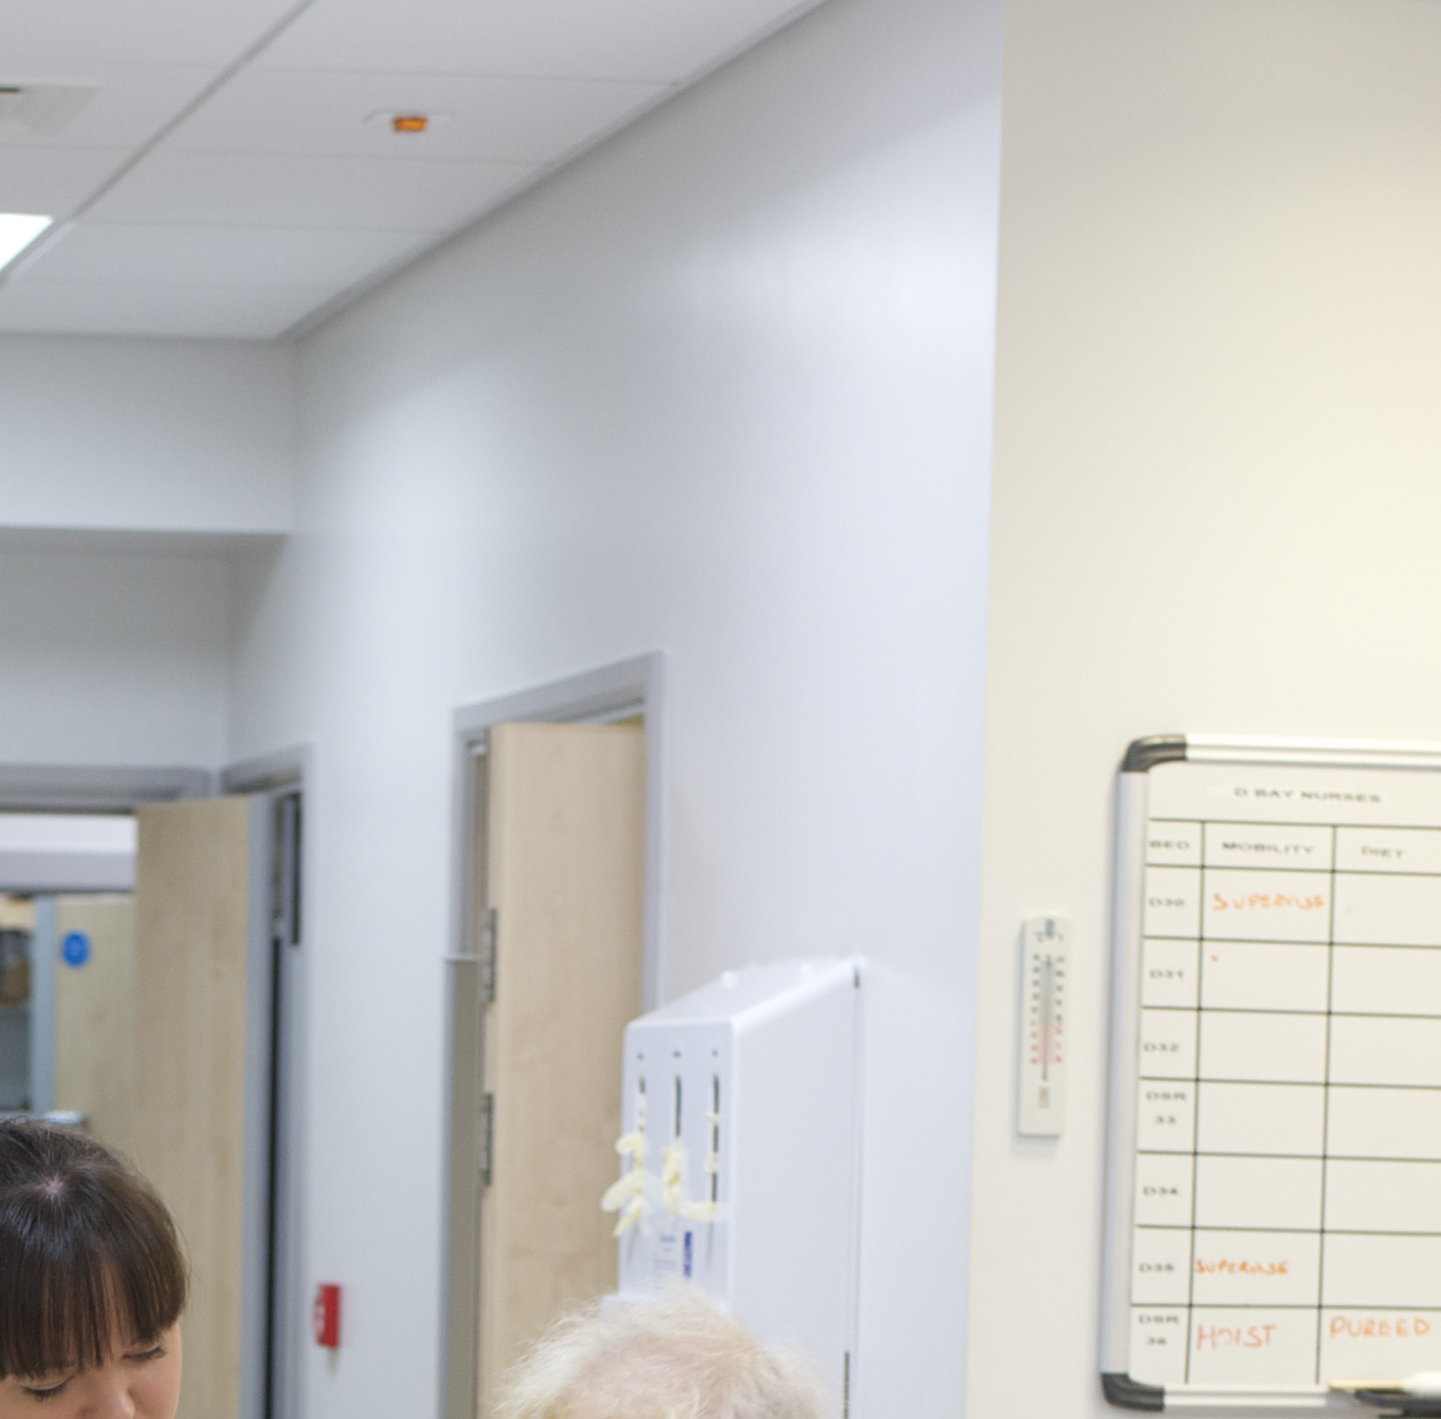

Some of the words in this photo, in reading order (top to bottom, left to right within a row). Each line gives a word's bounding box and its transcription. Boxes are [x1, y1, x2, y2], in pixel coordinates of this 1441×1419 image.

[1222, 840, 1315, 856] MOBILITY
[1195, 1324, 1278, 1351] HOIST
[1329, 1315, 1431, 1339] PUREED
